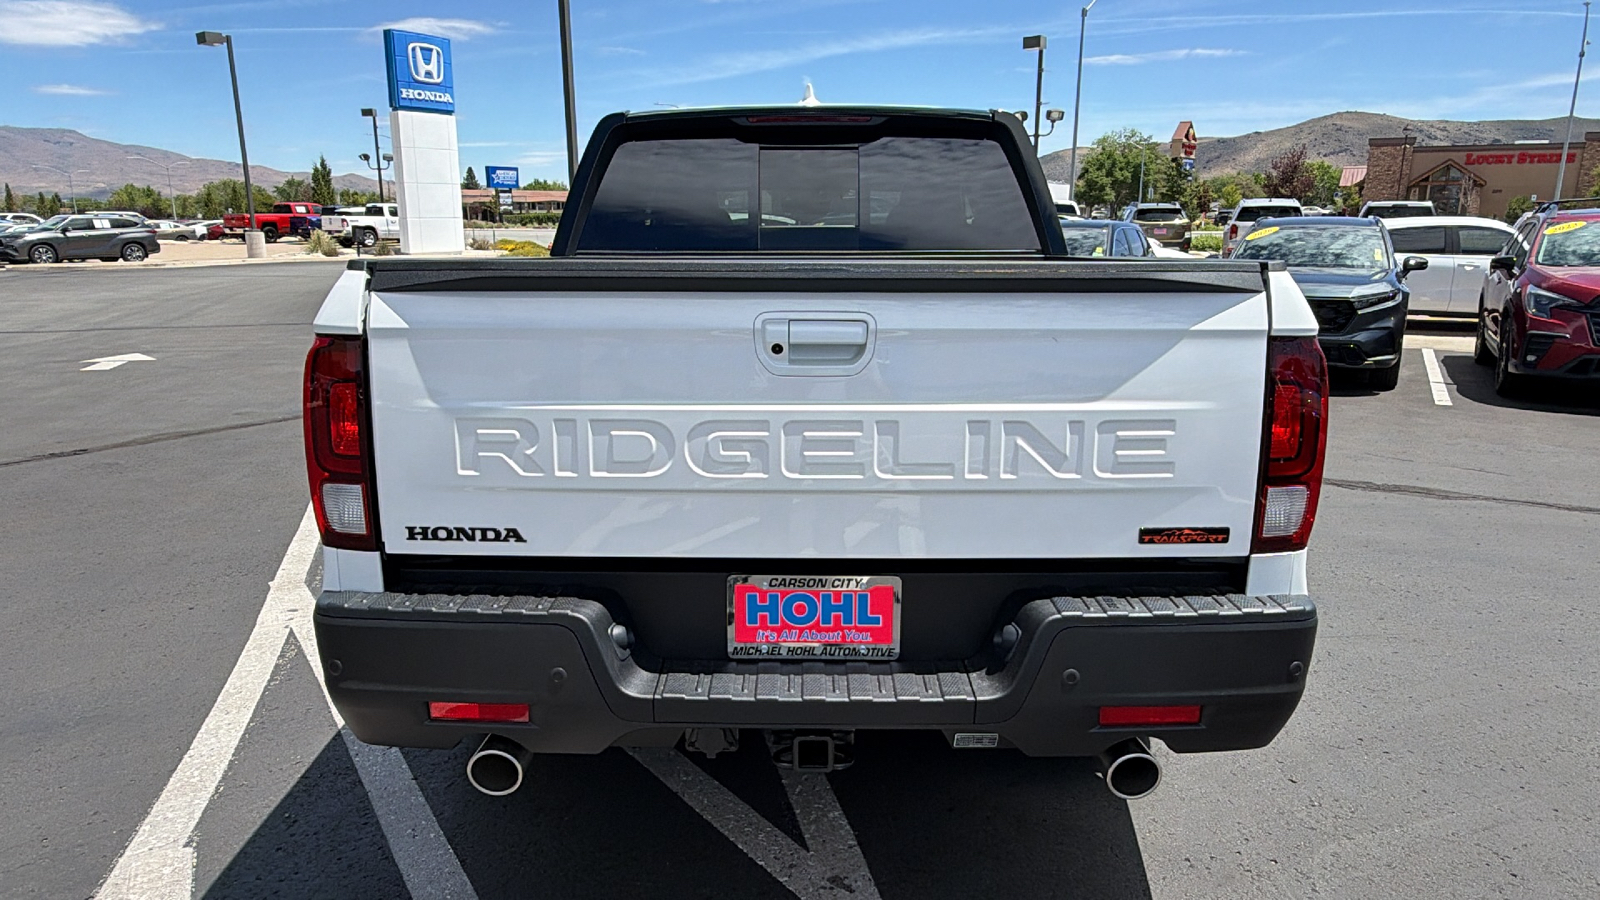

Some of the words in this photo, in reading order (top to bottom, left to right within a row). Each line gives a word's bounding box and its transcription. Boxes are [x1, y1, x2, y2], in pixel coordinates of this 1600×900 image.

[400, 88, 453, 103] HONDA
[1465, 152, 1515, 165] LUCKY
[454, 417, 1176, 479] RIDGELINE
[405, 526, 527, 543] HONDA
[1142, 534, 1227, 543] TRAILSPORT
[769, 577, 828, 588] CARSON
[831, 578, 862, 588] CITY
[746, 592, 882, 627] HOHL
[756, 629, 776, 642] It's
[779, 629, 798, 641] All
[800, 629, 841, 641] About
[844, 629, 872, 641] You.
[731, 646, 783, 656] MICHAEL
[786, 647, 818, 656] HOHL
[820, 647, 896, 657] AUTOMOTIVE
